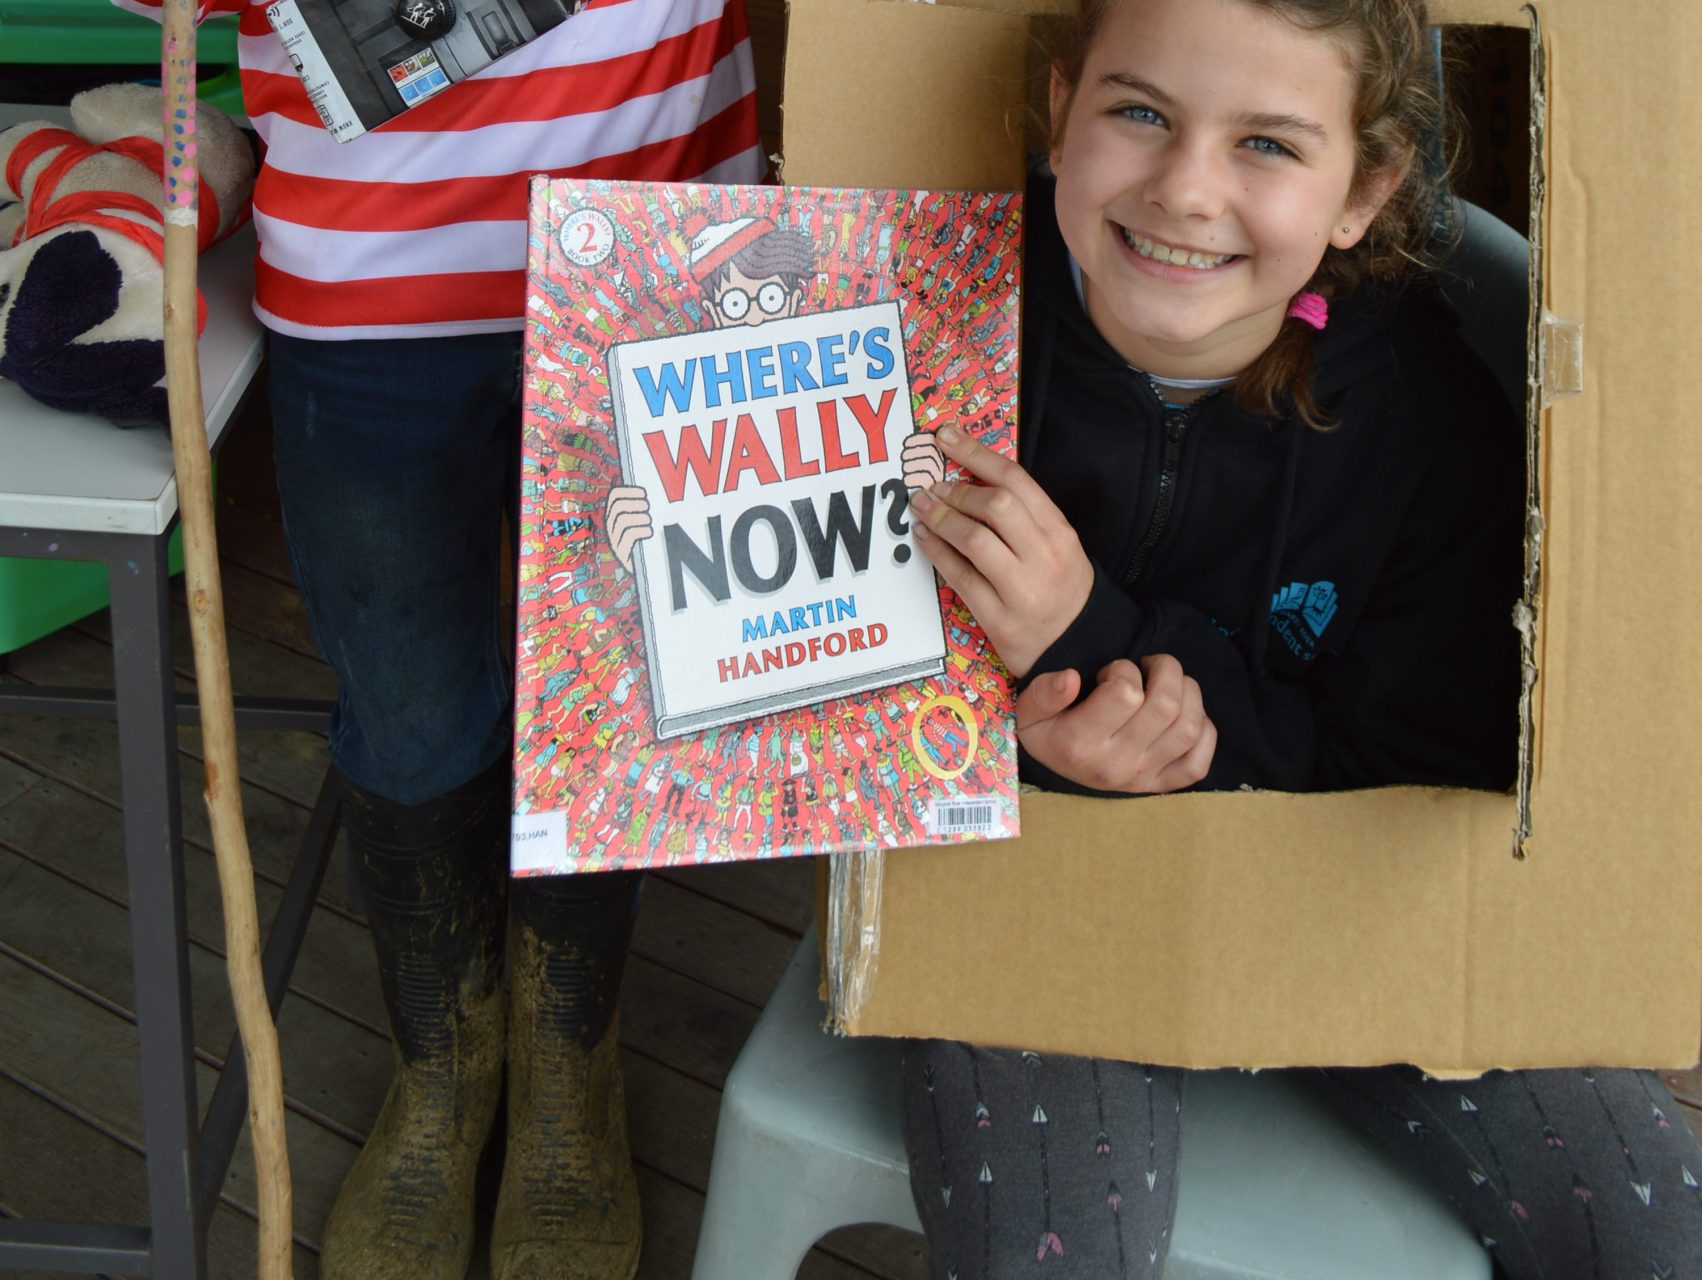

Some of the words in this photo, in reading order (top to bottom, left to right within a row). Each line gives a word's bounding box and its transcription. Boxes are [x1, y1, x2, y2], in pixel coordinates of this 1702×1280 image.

[567, 247, 591, 264] BOOK
[593, 243, 610, 262] TWO
[576, 222, 598, 253] 2
[632, 327, 896, 417] WHERE'S
[642, 388, 898, 504] WALLY
[662, 477, 912, 613] NOW?
[742, 594, 858, 643] MARTIN
[716, 622, 888, 683] HANDFORD
